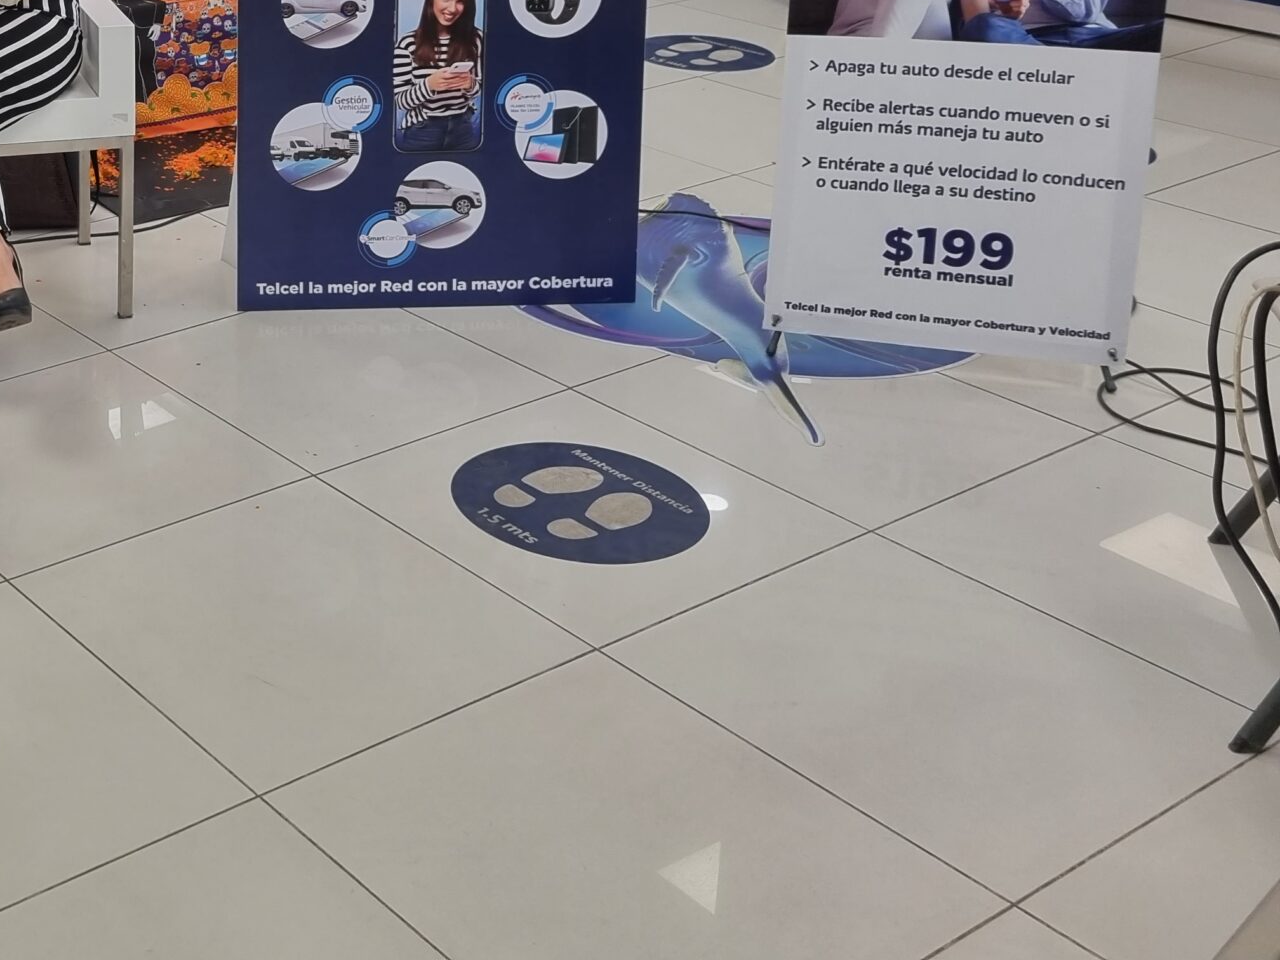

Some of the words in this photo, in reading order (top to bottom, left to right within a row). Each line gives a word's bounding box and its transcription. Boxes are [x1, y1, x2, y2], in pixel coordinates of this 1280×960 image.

[825, 59, 875, 76] Apaga
[880, 61, 896, 75] tu
[902, 63, 939, 78] auto
[944, 63, 994, 80] desde
[998, 66, 1012, 81] el
[1017, 69, 1075, 86] celular
[335, 95, 367, 105] Gestión
[339, 103, 371, 111] Vehicular
[822, 98, 874, 115] Recibe
[879, 100, 934, 117] alertas
[938, 104, 1000, 122] cuando
[1004, 109, 1075, 126] mueven
[1079, 115, 1091, 127] o
[1095, 113, 1111, 129] si
[816, 118, 873, 137] alguien
[878, 119, 912, 136] más
[917, 124, 978, 142] maneja
[982, 127, 1000, 141] tu
[1004, 129, 1044, 144] auto
[818, 156, 885, 174] Entérate
[889, 162, 899, 174] a
[903, 161, 934, 180] qué
[938, 164, 1018, 182] velocidad
[1022, 169, 1038, 184] lo
[1043, 172, 1126, 191] conducen
[816, 177, 826, 188] o
[830, 176, 889, 193] cuando
[893, 179, 931, 198] llega
[935, 184, 945, 197] a
[949, 185, 969, 199] su
[973, 185, 1036, 204] destino
[882, 227, 1014, 271] $199
[256, 282, 304, 296] Telcel
[308, 281, 323, 294] la
[328, 280, 376, 298] mejor
[380, 279, 413, 293] Red
[418, 280, 448, 292] con
[452, 278, 468, 291] la
[471, 278, 525, 294] mayor
[528, 275, 613, 290] Cobertura
[883, 265, 933, 281] renta
[937, 270, 1014, 288] mensual
[785, 300, 818, 312] Telcel
[821, 303, 831, 313] la
[834, 306, 867, 320] mejor
[870, 308, 893, 319] Red
[895, 312, 917, 322] con
[920, 313, 930, 323] la
[933, 316, 972, 329] mayor
[974, 318, 1035, 334] Cobertura
[1038, 326, 1047, 336] y
[1049, 326, 1111, 341] Velocidad
[570, 448, 632, 483] Mantener
[632, 480, 695, 516] Distancia
[477, 507, 502, 526] 1.5
[503, 519, 538, 545] mts
